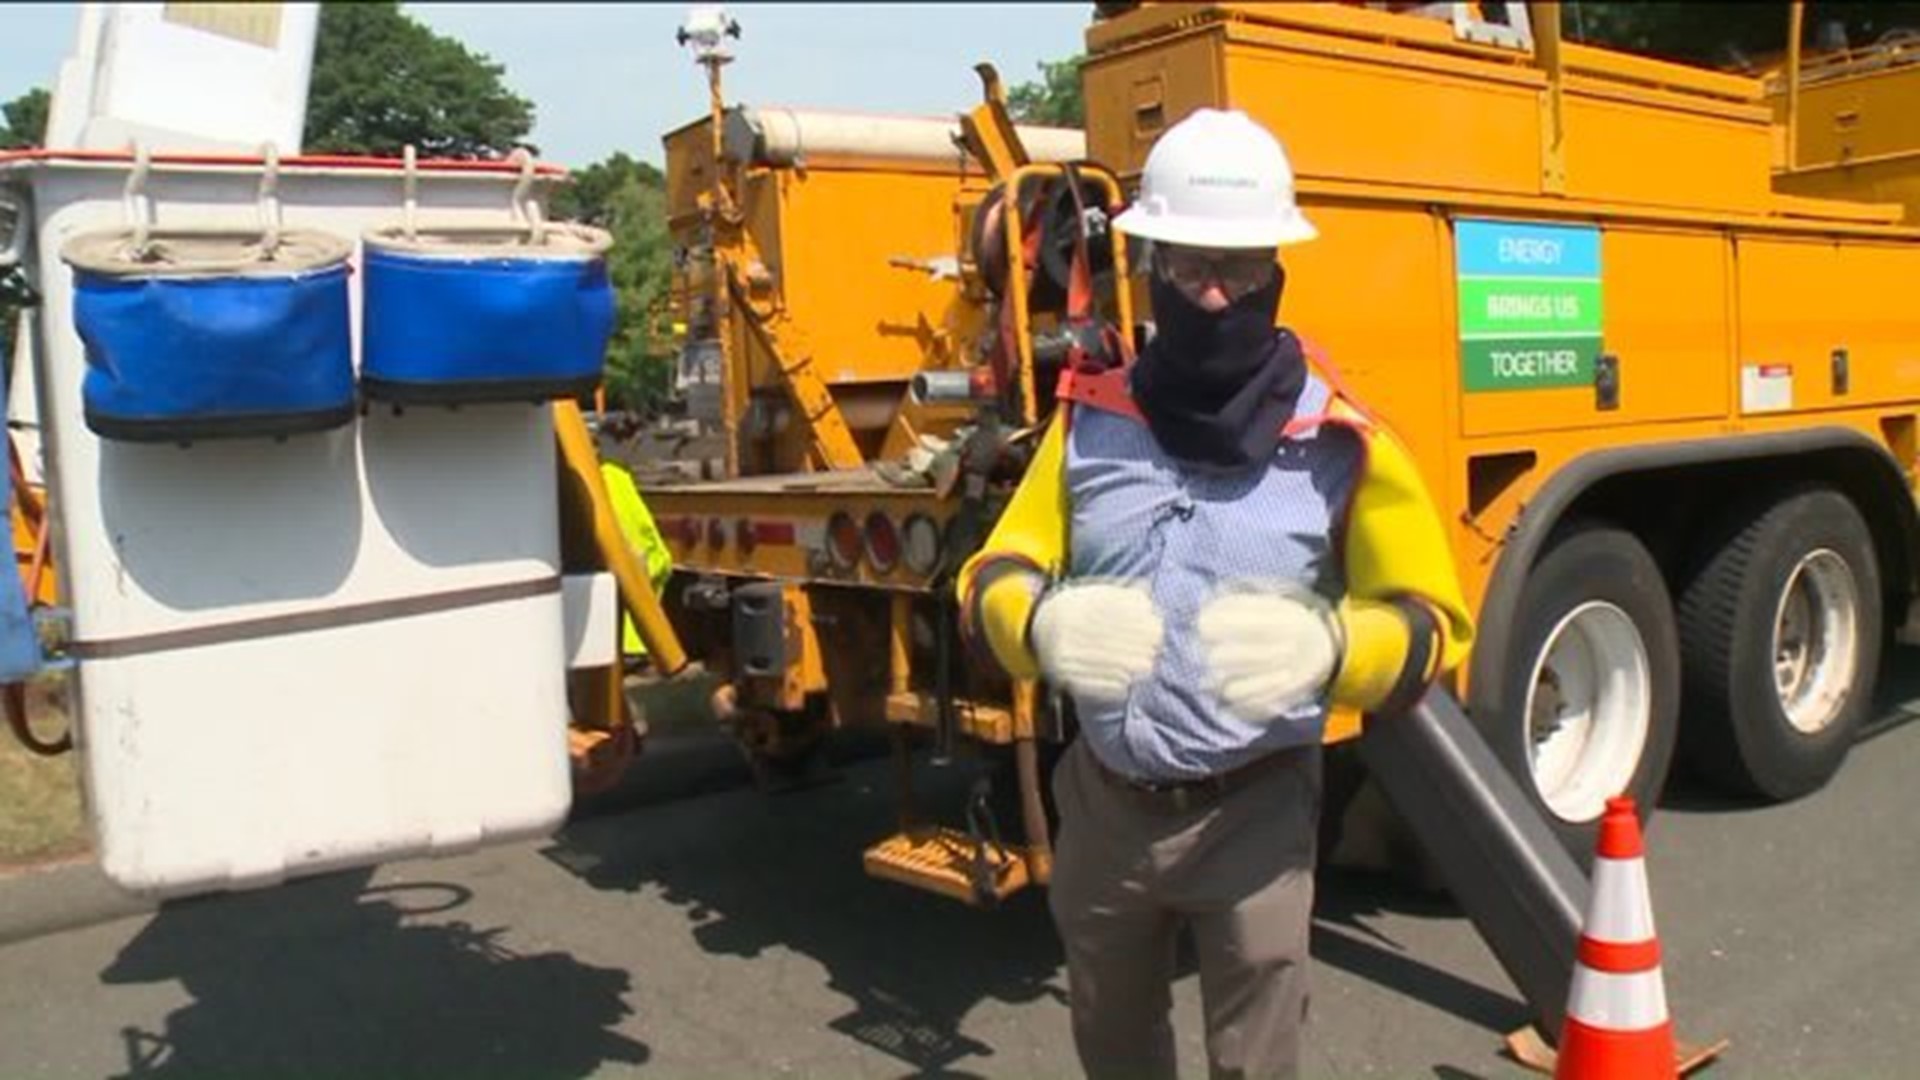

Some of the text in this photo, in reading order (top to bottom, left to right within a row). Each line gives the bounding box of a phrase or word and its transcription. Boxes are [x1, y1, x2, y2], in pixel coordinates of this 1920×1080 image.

[1499, 238, 1563, 264] ENERGY
[1487, 295, 1579, 319] BRINGS US
[1490, 351, 1577, 377] TOGETHER
